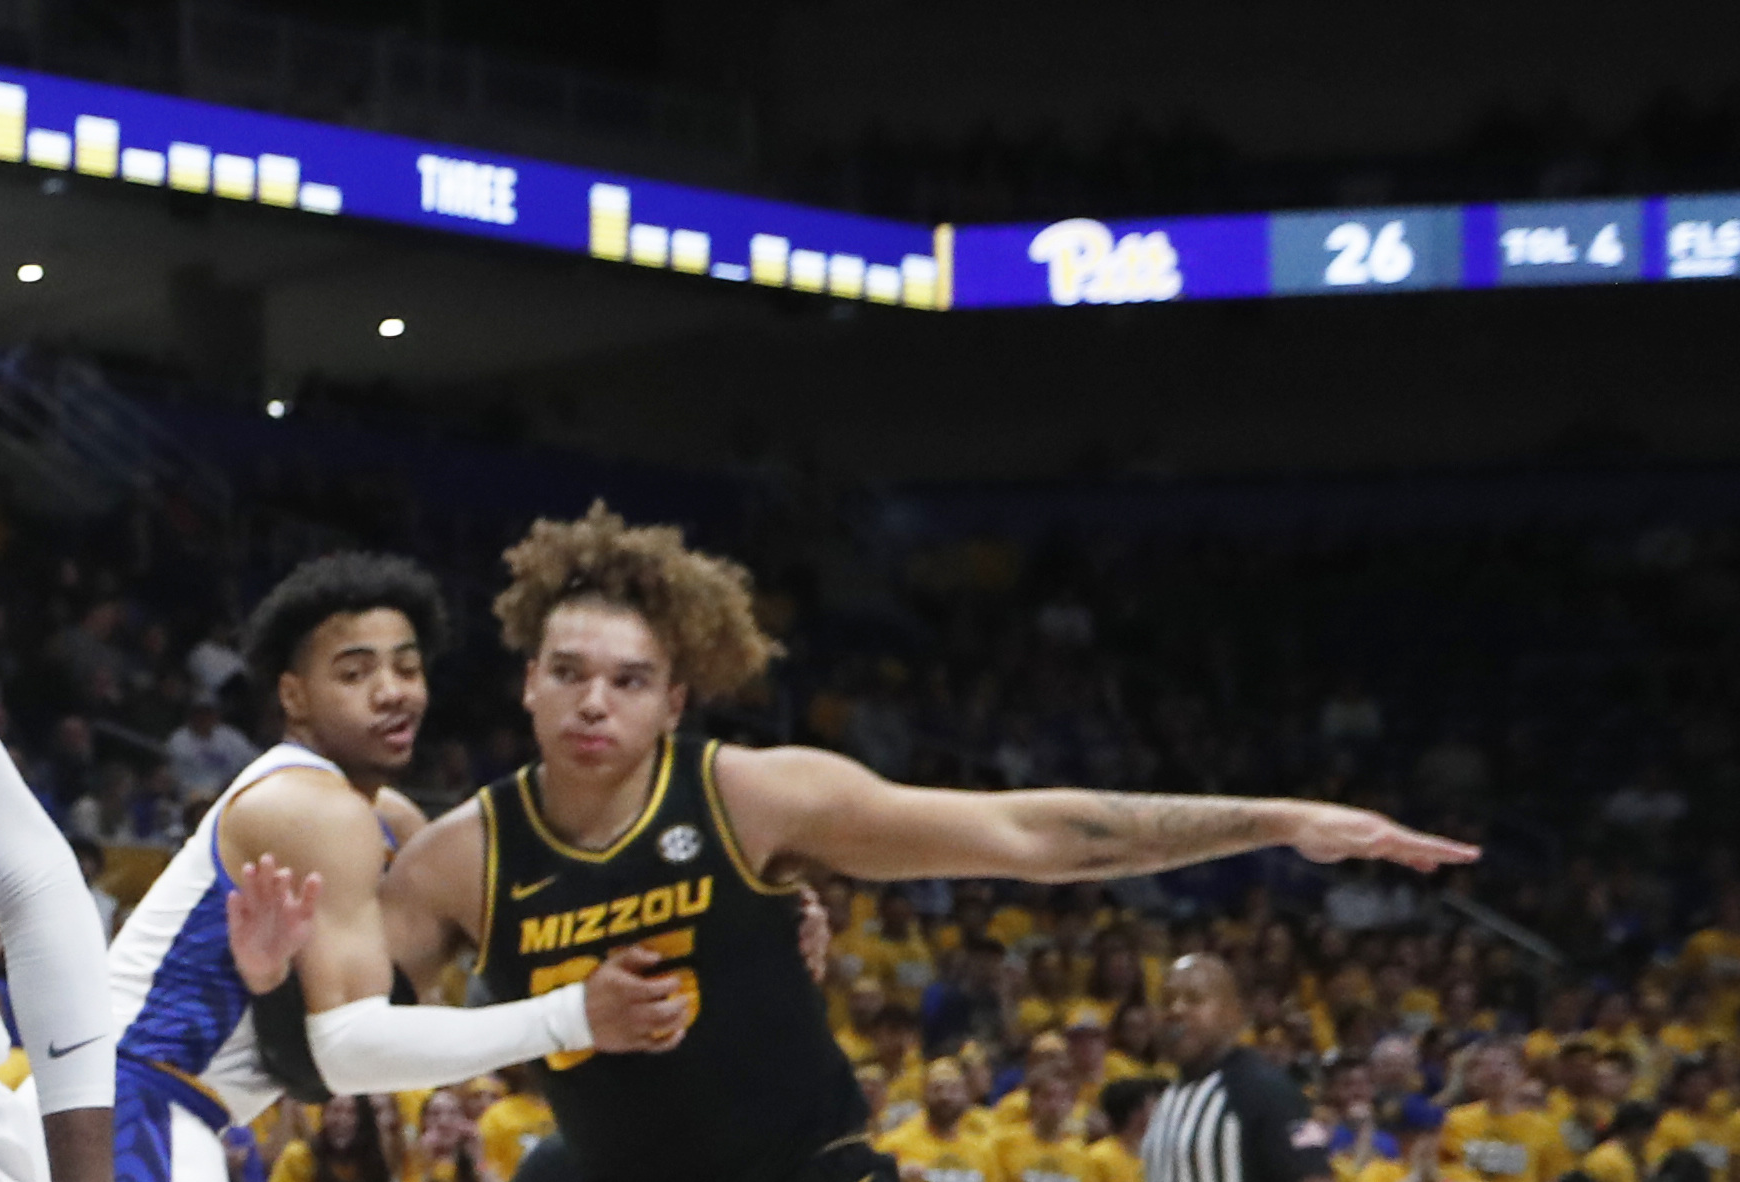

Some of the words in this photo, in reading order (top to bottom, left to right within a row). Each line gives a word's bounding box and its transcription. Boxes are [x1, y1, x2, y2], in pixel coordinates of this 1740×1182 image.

[1029, 217, 1183, 306] Pitt
[1324, 220, 1415, 286] 26
[1585, 222, 1624, 267] 6
[518, 875, 714, 956] MIZZOU
